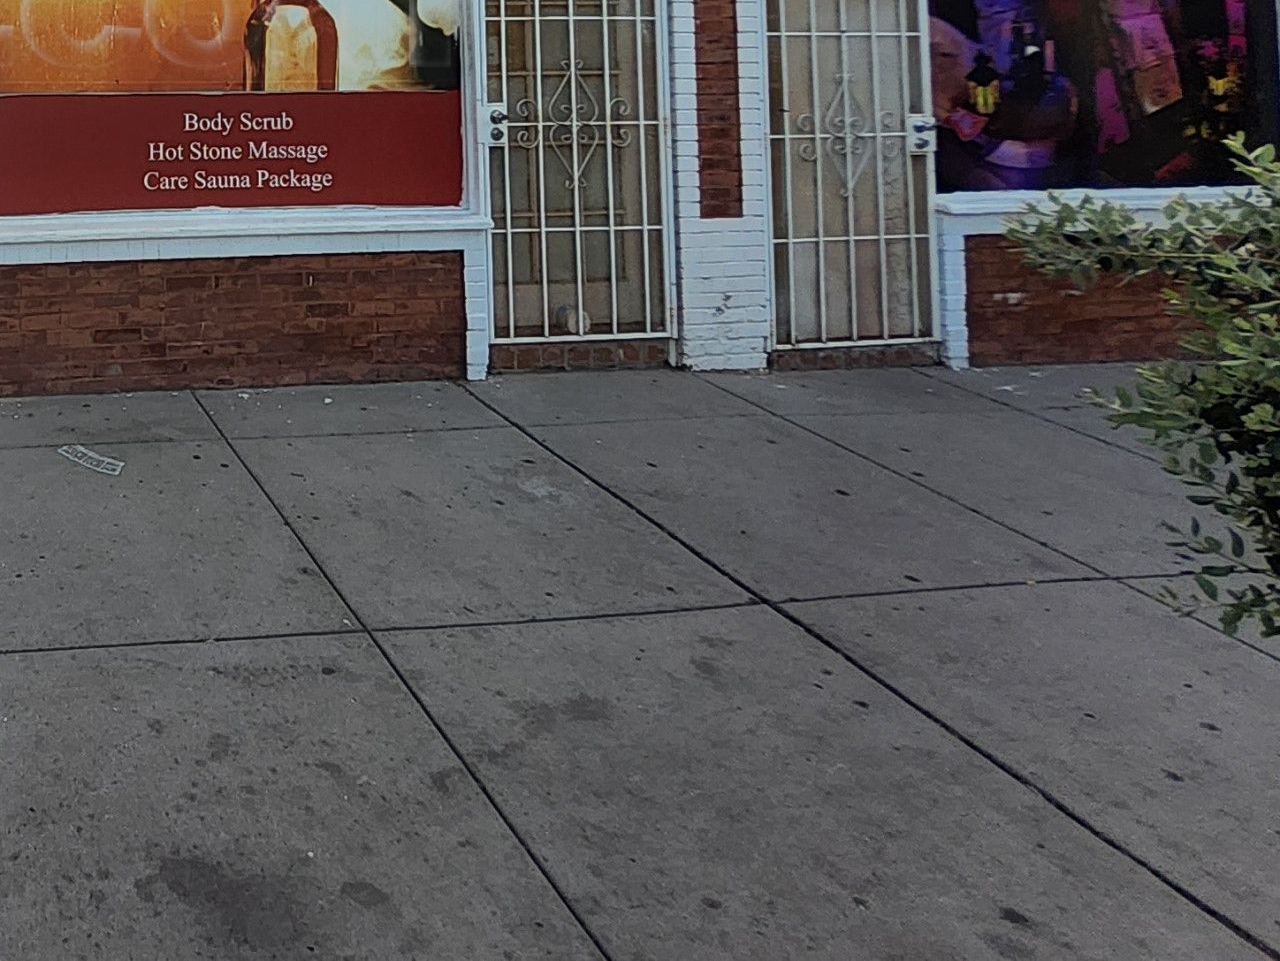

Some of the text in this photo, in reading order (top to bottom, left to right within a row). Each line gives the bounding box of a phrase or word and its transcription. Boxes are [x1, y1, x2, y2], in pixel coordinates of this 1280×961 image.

[184, 112, 293, 135] Body Scrub
[149, 142, 327, 162] Hot Stone Massage
[144, 169, 332, 191] Care Sauna Package
